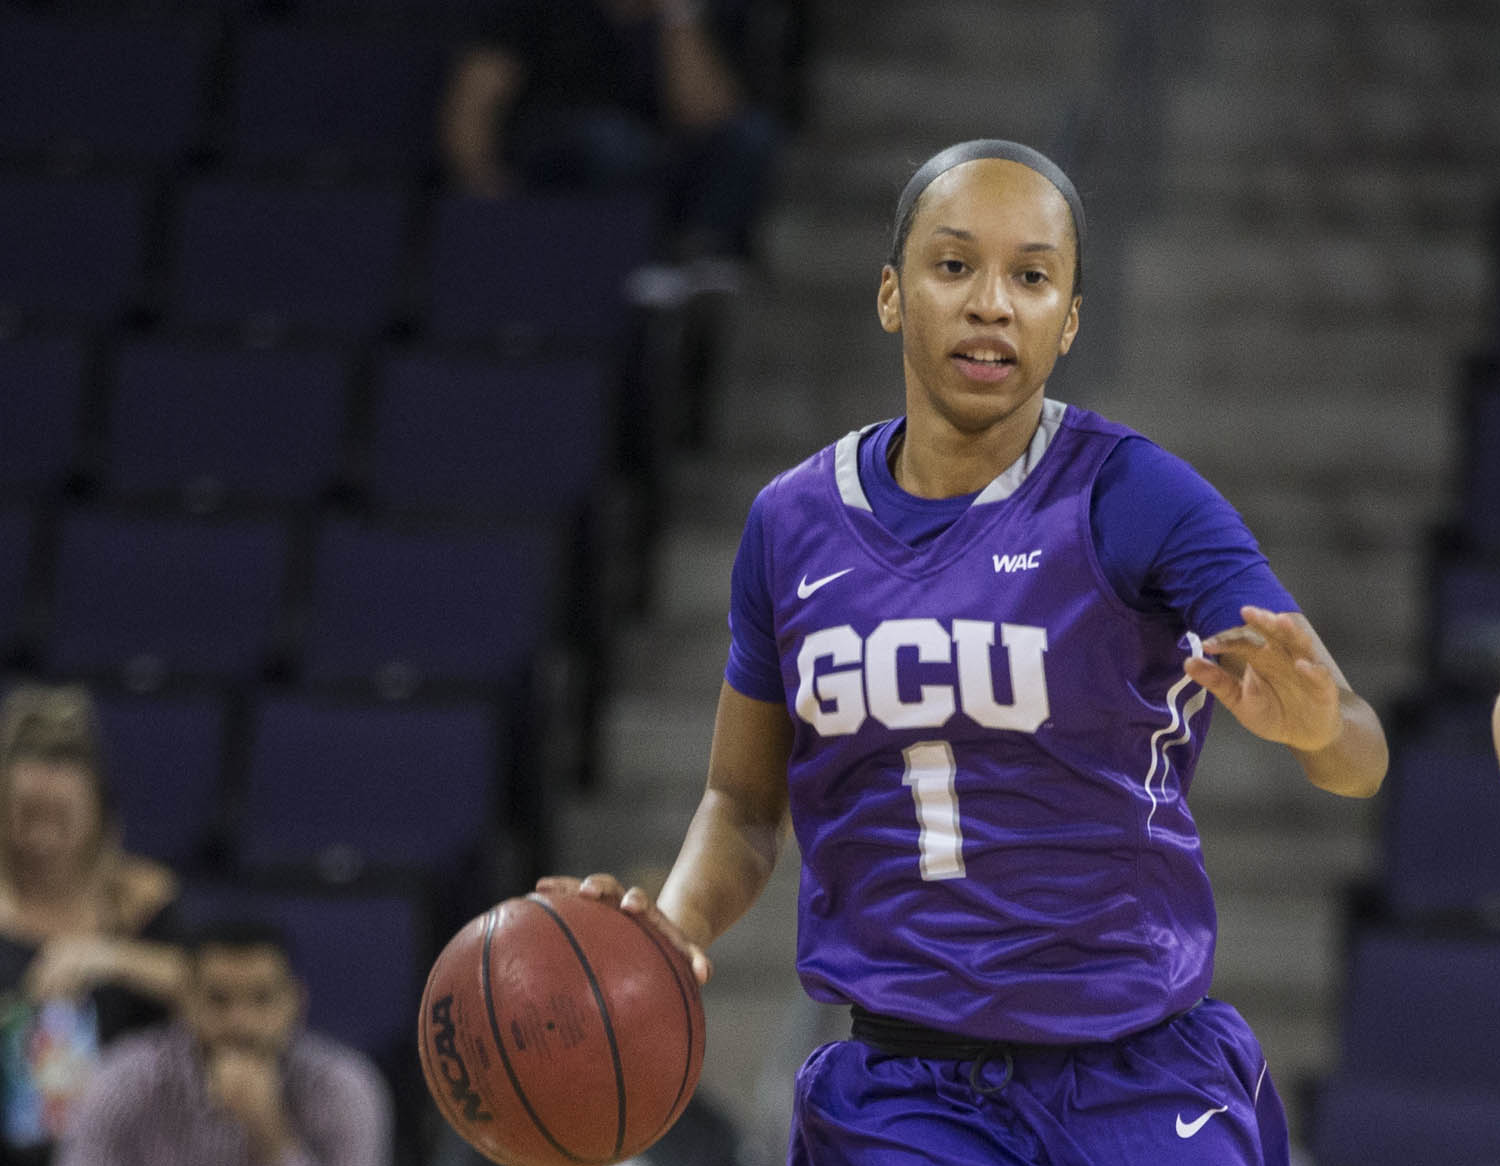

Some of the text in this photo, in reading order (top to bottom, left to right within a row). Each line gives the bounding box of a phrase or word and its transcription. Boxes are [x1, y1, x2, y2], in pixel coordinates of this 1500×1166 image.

[992, 549, 1042, 573] WAC
[796, 618, 1050, 736] GCU
[902, 741, 967, 882] 1
[432, 993, 493, 1121] NCAA
